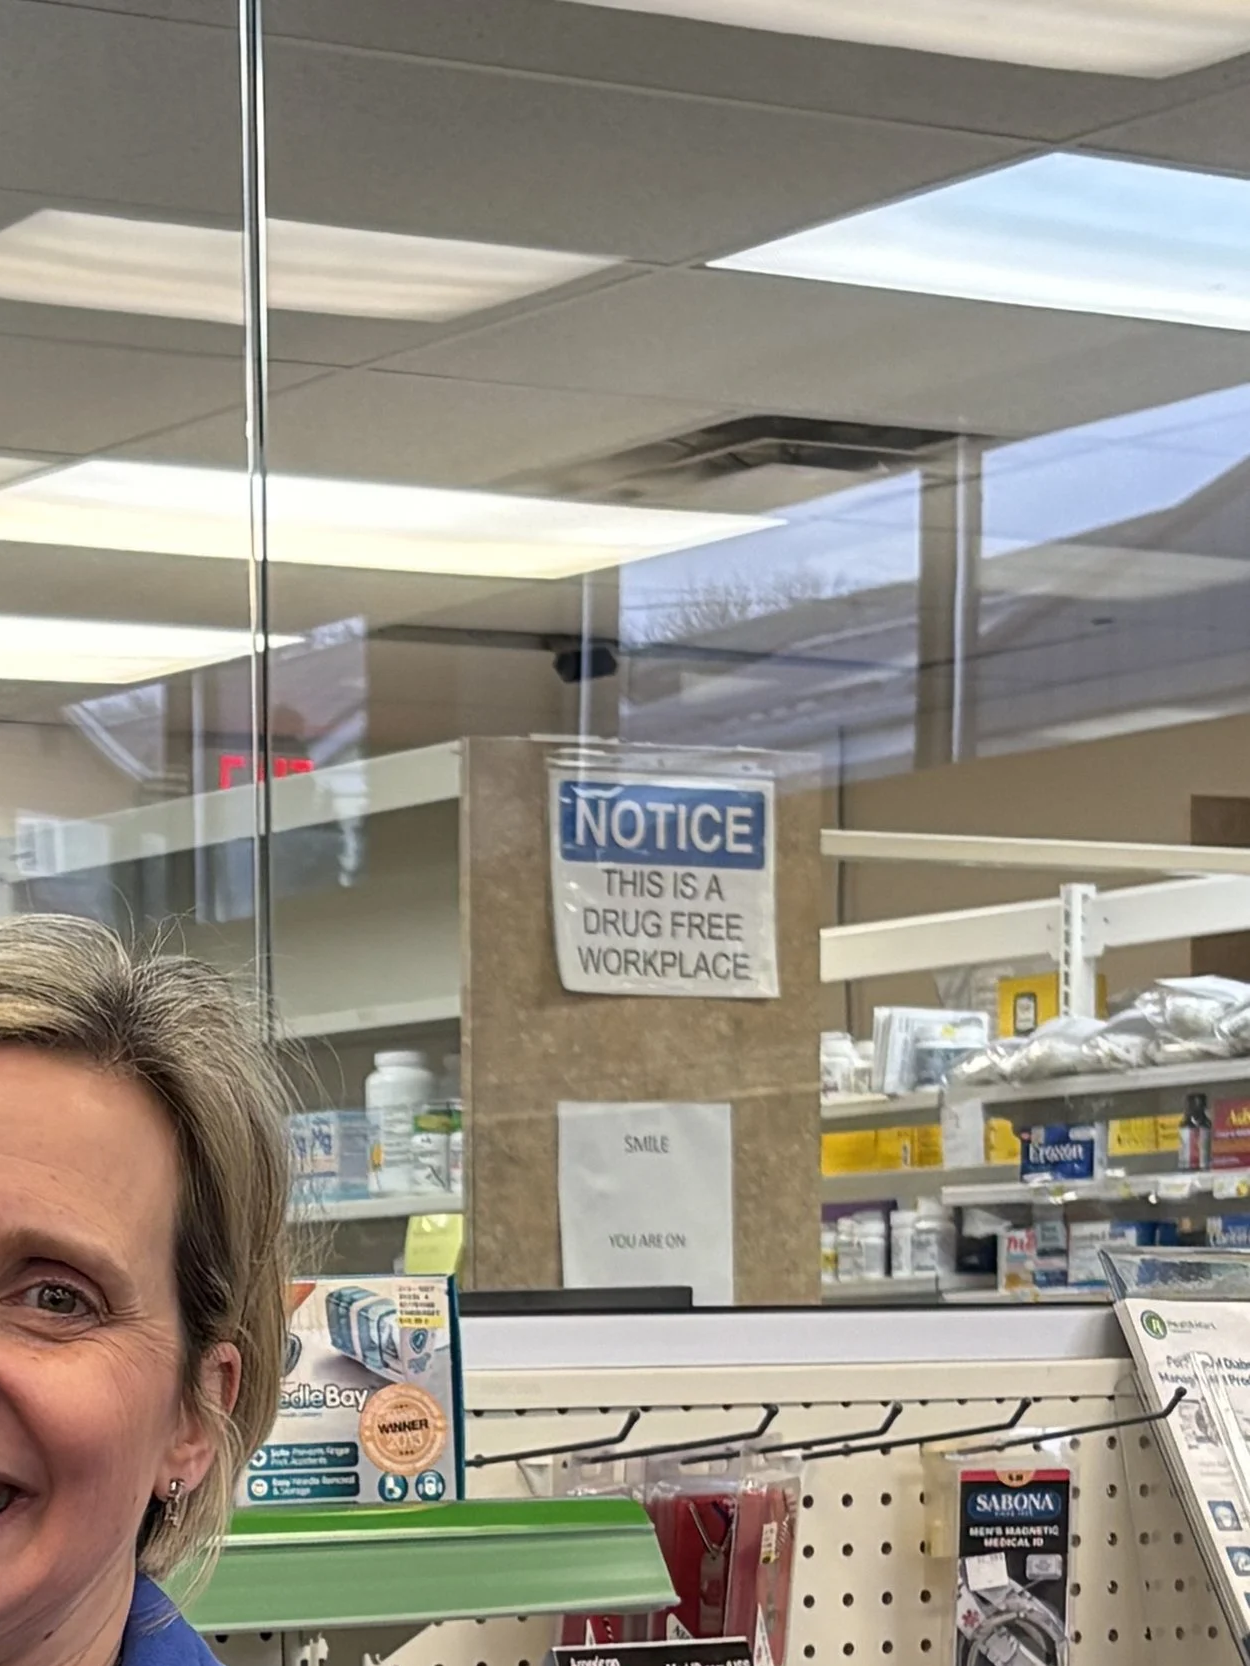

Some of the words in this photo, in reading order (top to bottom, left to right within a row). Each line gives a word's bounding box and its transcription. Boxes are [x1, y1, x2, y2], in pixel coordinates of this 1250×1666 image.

[575, 797, 754, 854] NOTICE
[602, 868, 664, 899] THIS
[673, 871, 698, 900] IS
[705, 874, 725, 901] A
[583, 907, 663, 939] DRUG
[670, 911, 745, 942] FREE
[578, 946, 754, 981] WORKPLACE
[624, 1134, 669, 1154] SMILE
[608, 1233, 636, 1249] YOU
[638, 1233, 664, 1249] ARE
[665, 1232, 688, 1249] ON
[378, 1418, 429, 1434] WINNER
[976, 1492, 1054, 1512] SABONA
[1005, 1525, 1060, 1537] MAGNETIC
[983, 1538, 1030, 1548] MEDICAL
[1032, 1537, 1045, 1548] ID
